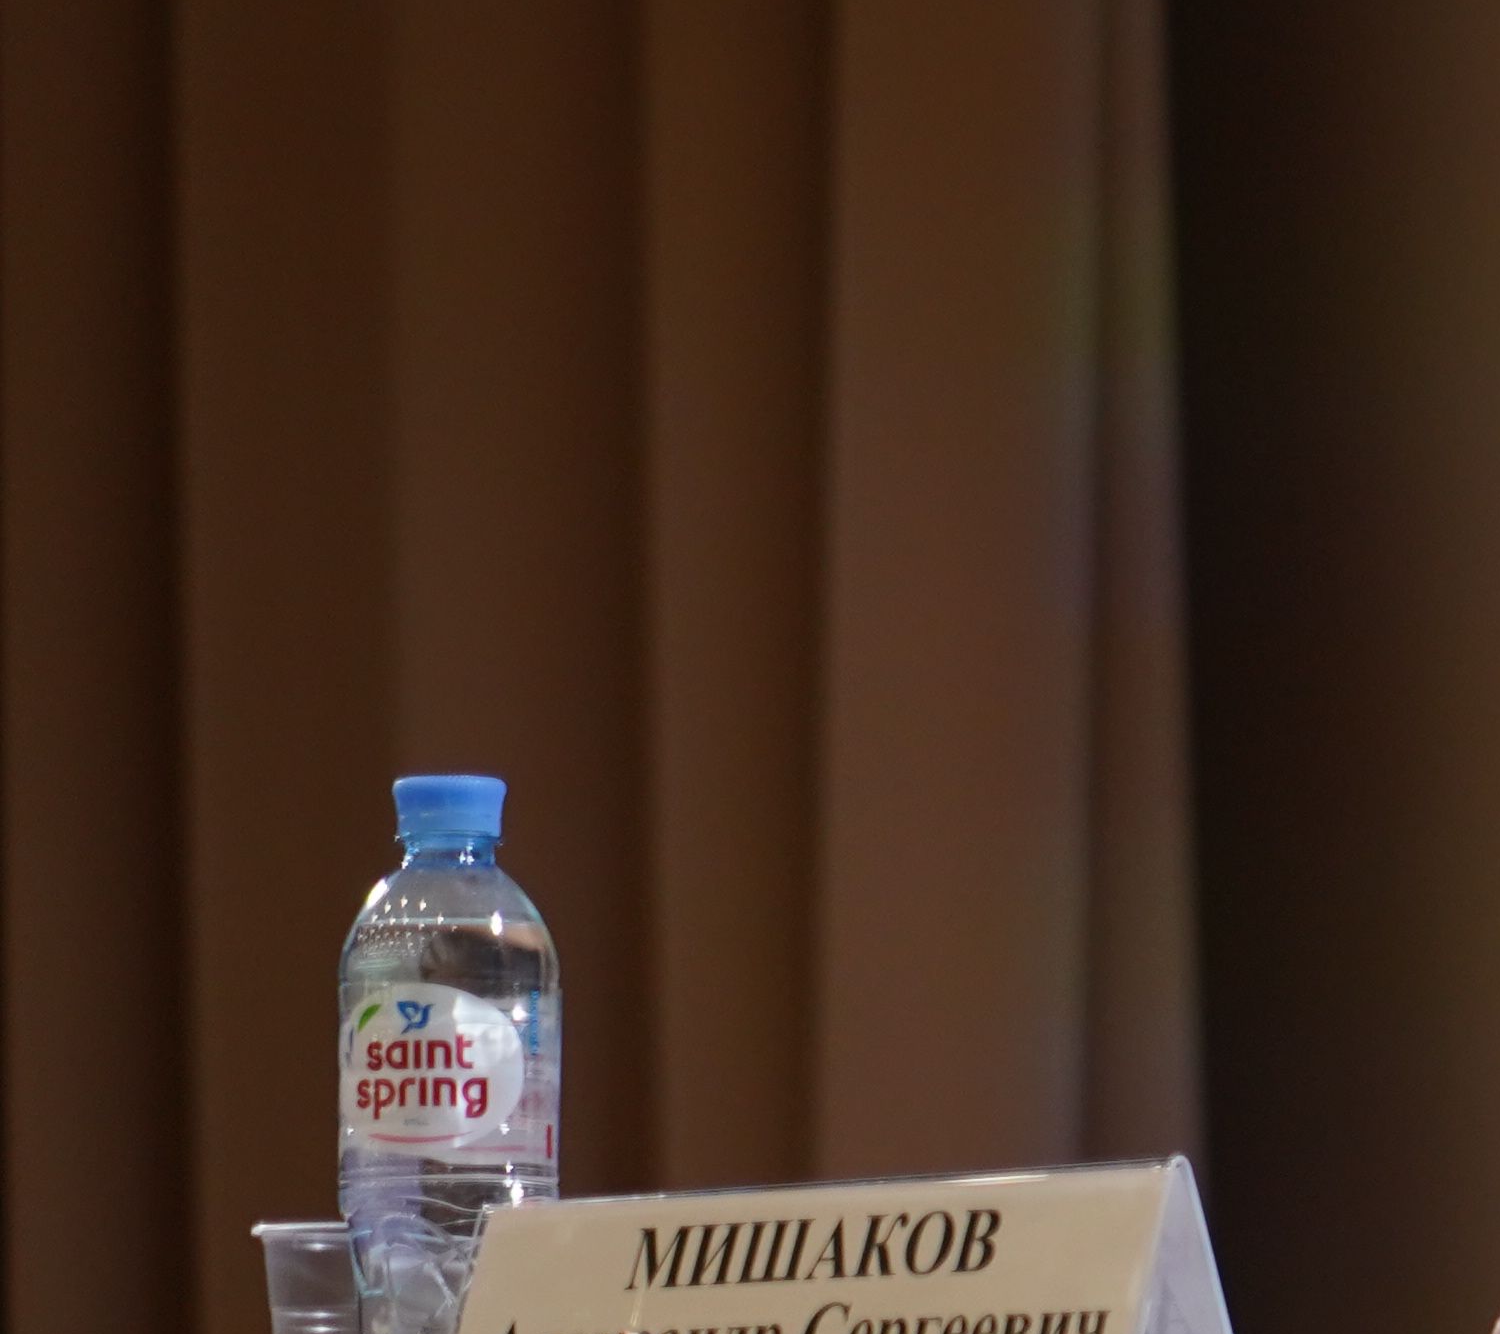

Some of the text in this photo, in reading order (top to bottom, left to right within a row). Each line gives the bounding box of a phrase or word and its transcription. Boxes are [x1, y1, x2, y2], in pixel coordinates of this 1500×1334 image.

[367, 1033, 475, 1071] saint
[356, 1077, 489, 1120] spring
[623, 1208, 1002, 1291] МИШАКОВ
